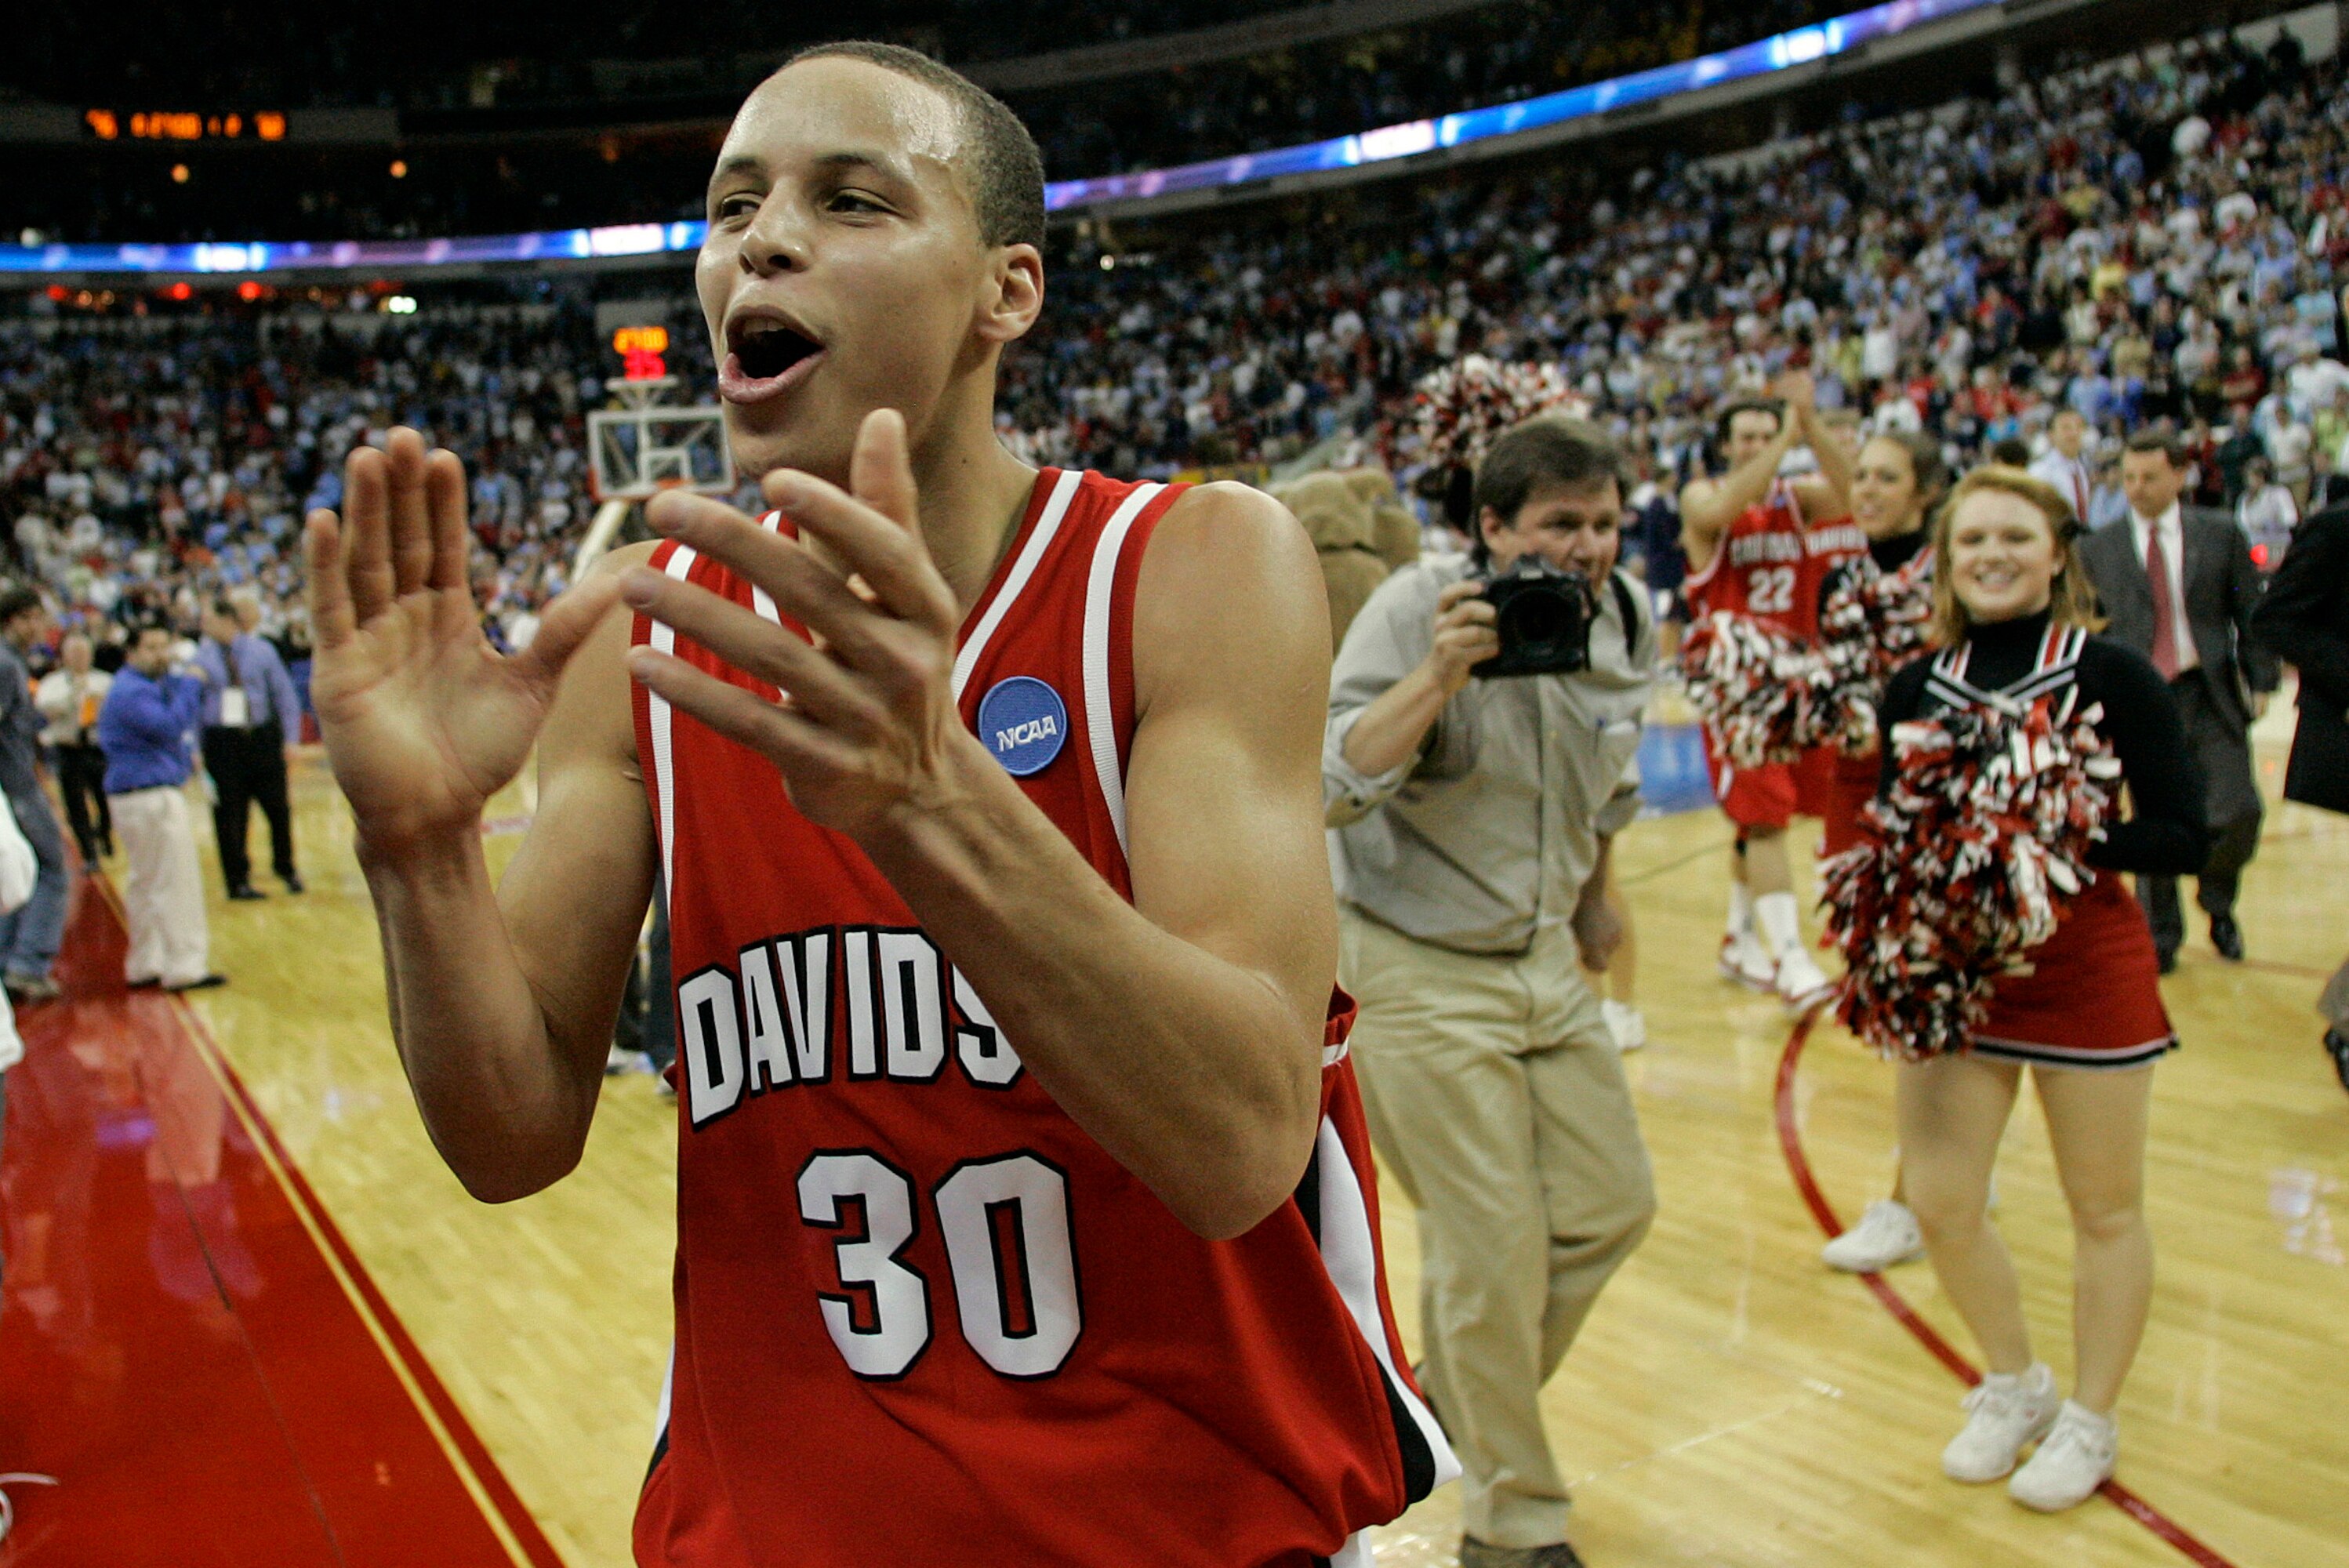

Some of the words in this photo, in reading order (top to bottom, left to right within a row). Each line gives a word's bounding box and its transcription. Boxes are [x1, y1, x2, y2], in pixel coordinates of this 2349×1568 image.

[1748, 565, 1796, 613] 22
[996, 715, 1058, 753] NCAA
[797, 1147, 1085, 1382] 30
